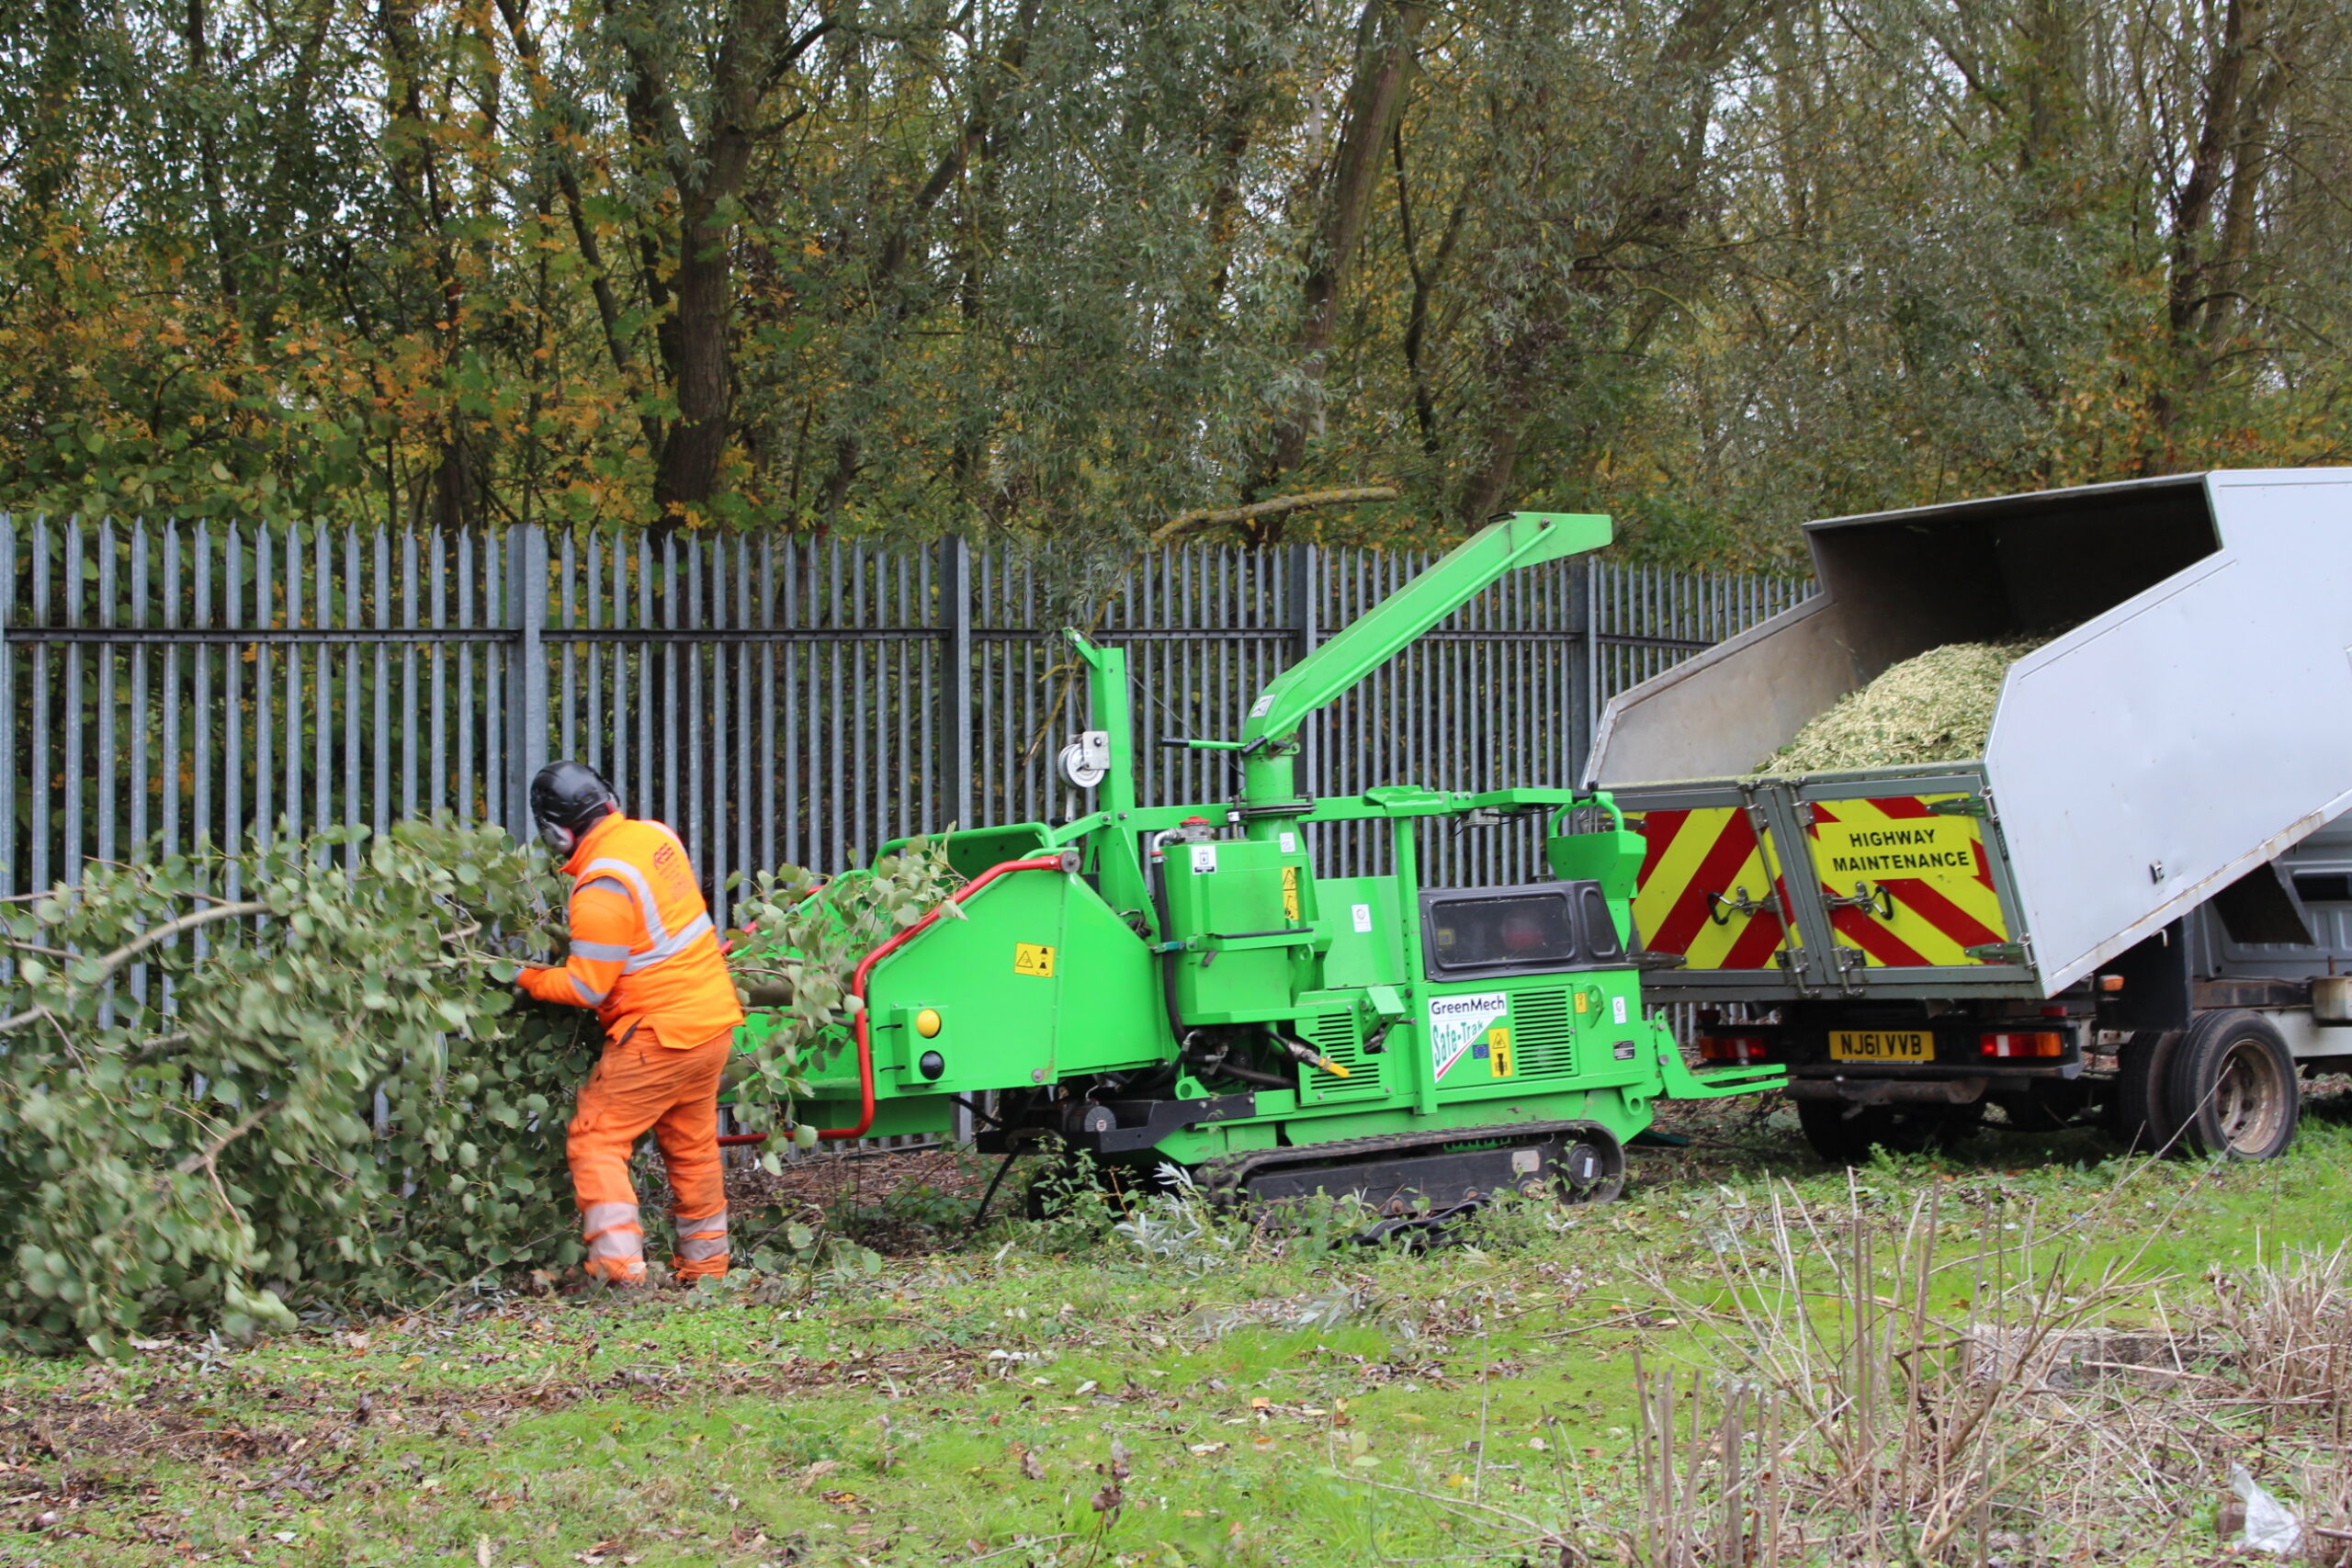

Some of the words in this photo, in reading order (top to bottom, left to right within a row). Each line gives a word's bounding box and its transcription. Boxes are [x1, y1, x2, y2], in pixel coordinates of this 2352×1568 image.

[1849, 829, 1936, 847] HIGHWAY
[1832, 852, 1970, 872] MAINTENANCE
[1430, 995, 1505, 1015] GreenMech
[1432, 1021, 1484, 1067] Safe-Trak
[1840, 1034, 1881, 1055] NJ61
[1885, 1034, 1922, 1055] VVB
